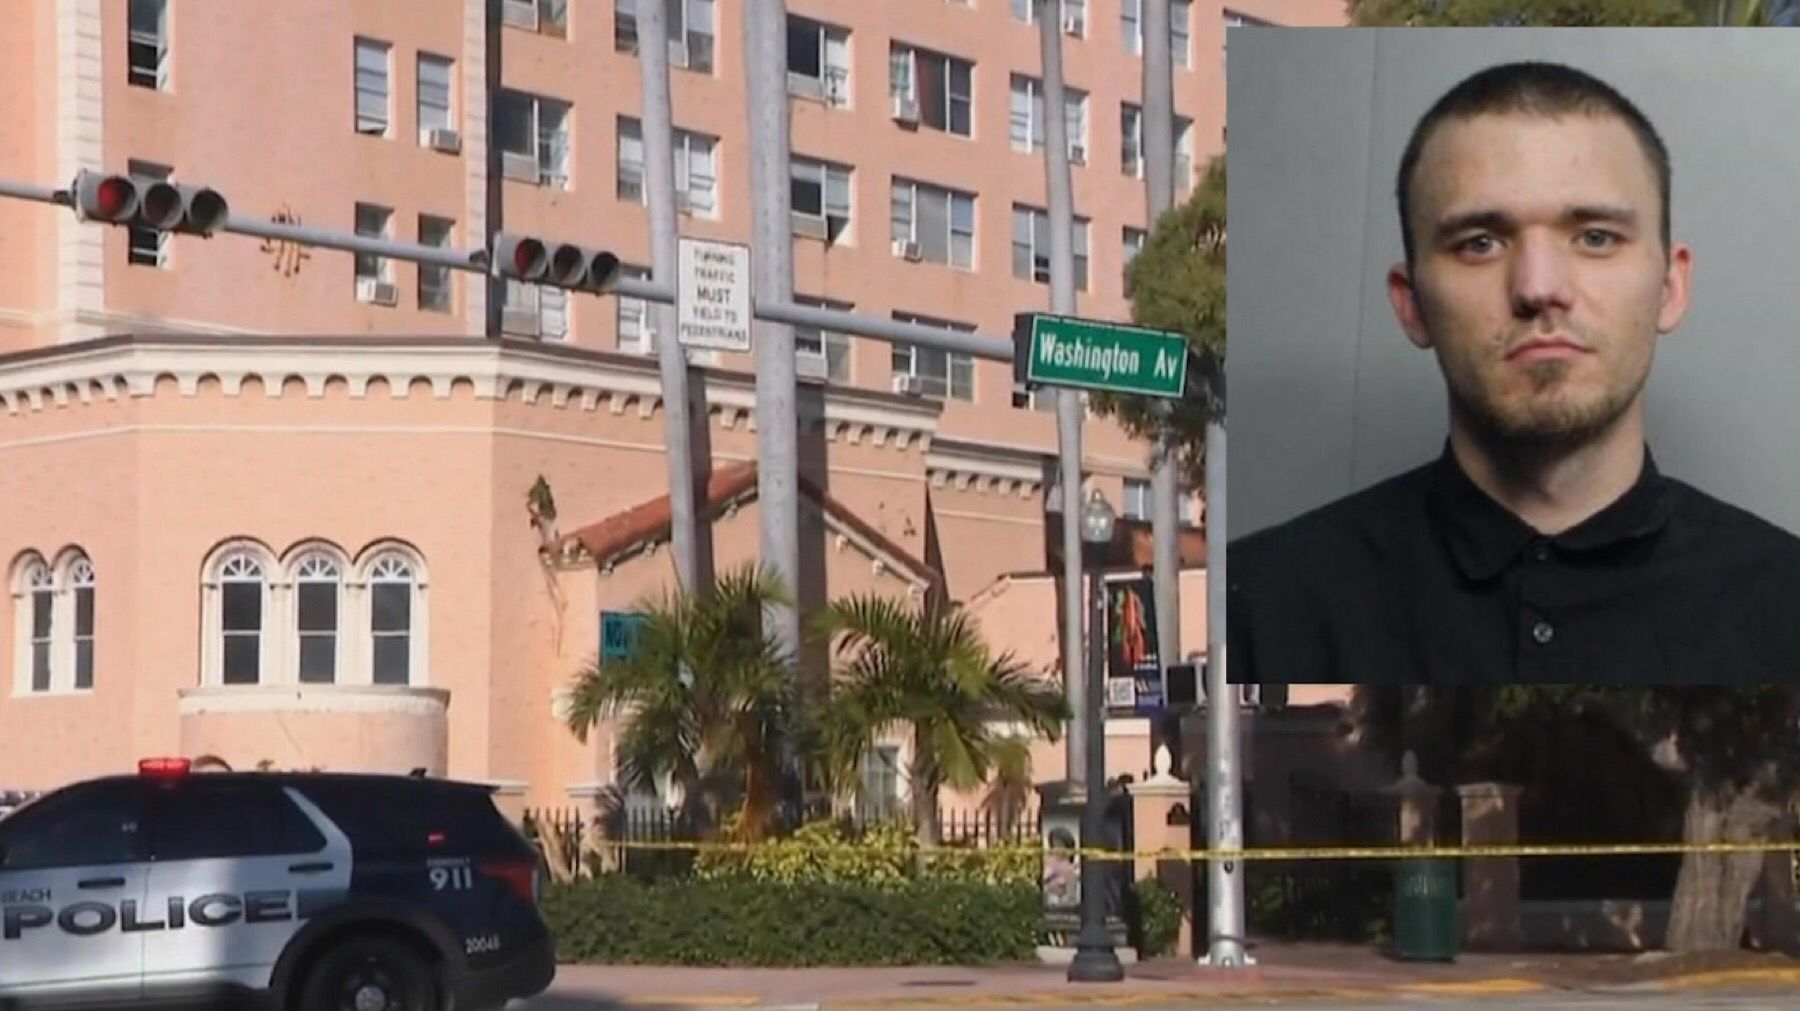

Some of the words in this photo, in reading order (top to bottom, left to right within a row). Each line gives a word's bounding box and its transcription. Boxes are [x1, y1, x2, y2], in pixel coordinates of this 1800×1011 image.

[694, 266, 735, 285] TRAFFIC
[696, 285, 731, 304] MUST
[1039, 332, 1140, 382] Washington
[1153, 347, 1178, 380] Av
[429, 867, 473, 891] 911
[4, 890, 293, 939] POLICE
